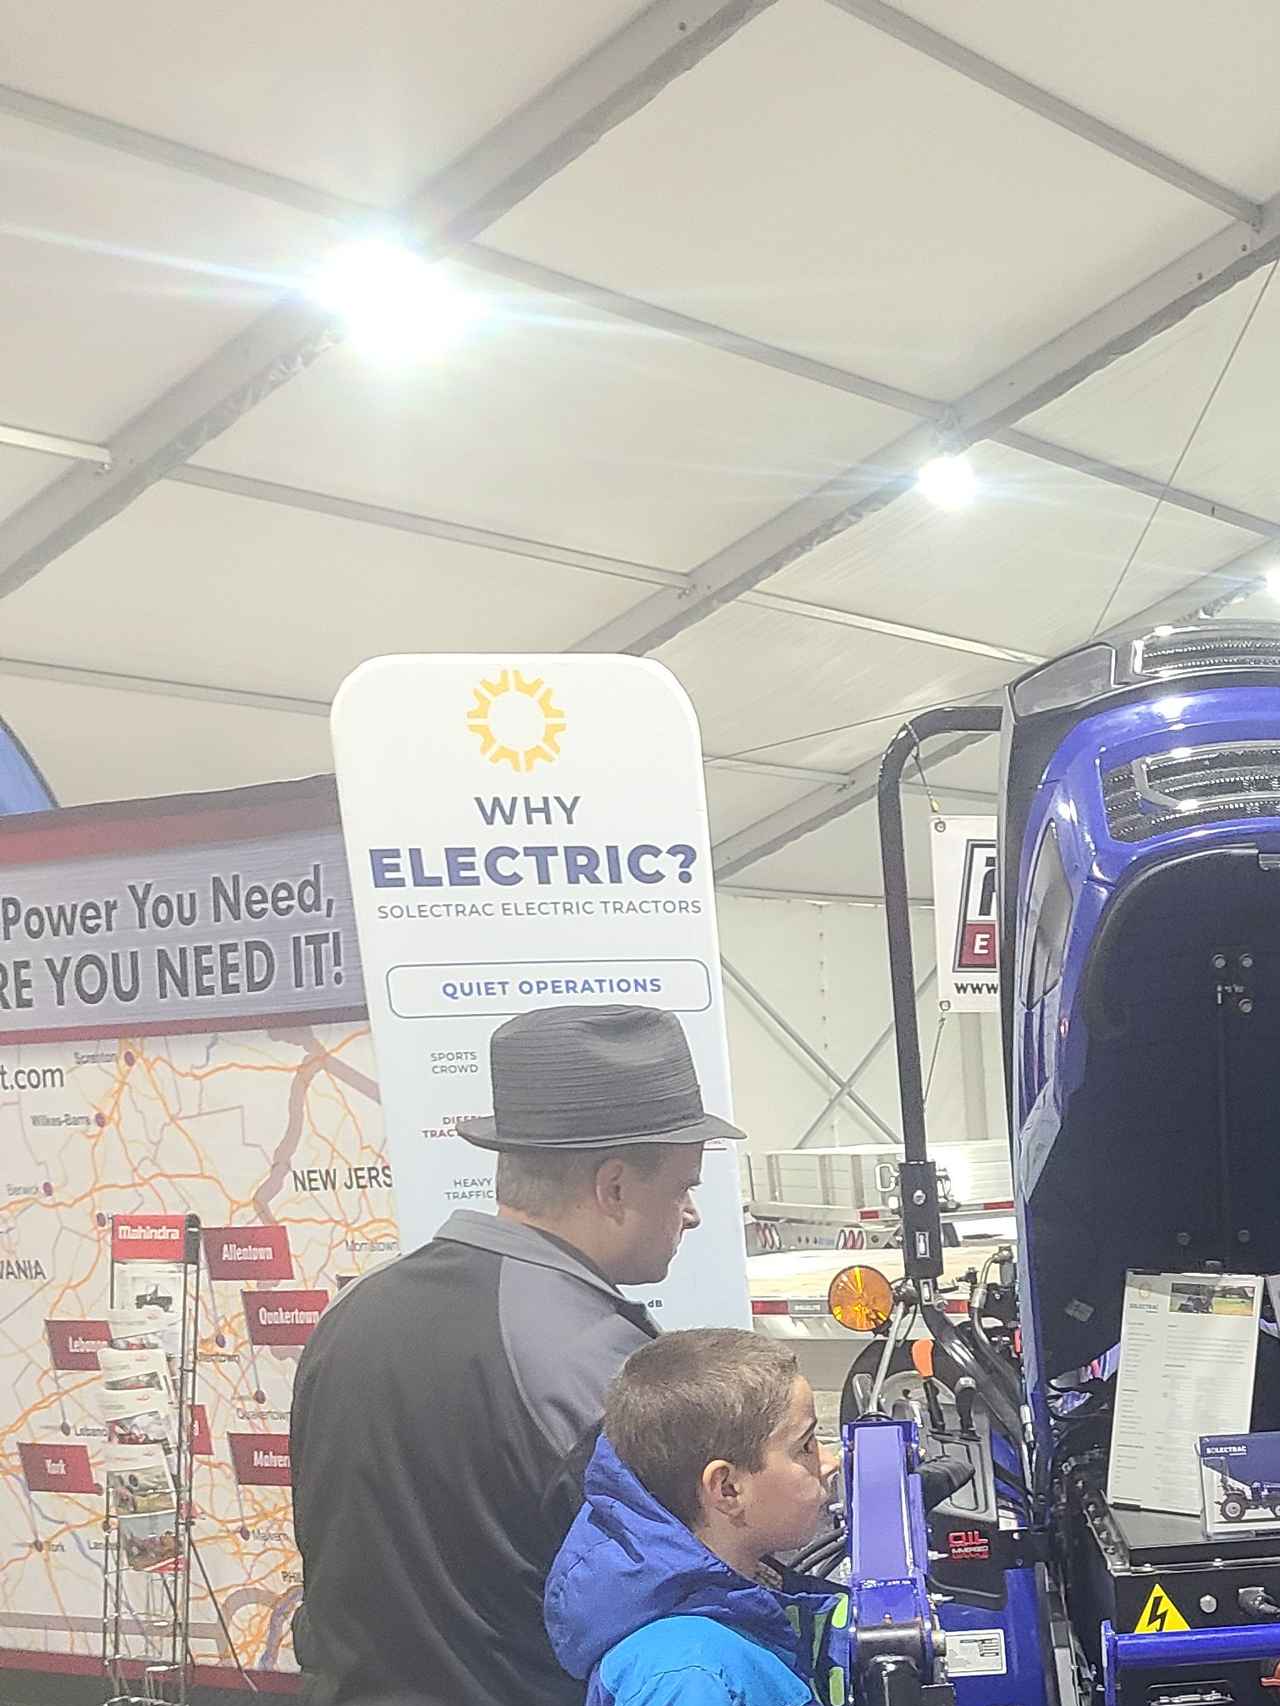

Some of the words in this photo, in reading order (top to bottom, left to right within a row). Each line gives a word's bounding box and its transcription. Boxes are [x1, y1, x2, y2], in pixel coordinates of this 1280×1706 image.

[474, 796, 581, 825] WHY
[369, 844, 698, 888] ELECTRIC?
[1, 896, 118, 941] Power
[128, 883, 198, 929] You
[212, 863, 334, 923] Need,
[377, 902, 495, 919] SOLECTRAC
[501, 901, 595, 917] ELECTRIC
[600, 899, 702, 915] TRACTORS
[46, 950, 140, 1006] YOU
[156, 940, 275, 999] NEED
[291, 931, 344, 988] IT!
[441, 980, 509, 1000] QUIET
[518, 978, 662, 996] OPERATIONS
[430, 1051, 478, 1062] SPORTS
[0, 1064, 65, 1090] t.com
[431, 1064, 479, 1074] CROWD
[292, 1168, 337, 1193] NEW
[343, 1165, 393, 1190] JERS
[453, 1178, 493, 1188] HEAVY
[444, 1190, 494, 1201] TRAFFIC
[118, 1225, 180, 1240] Mahindra
